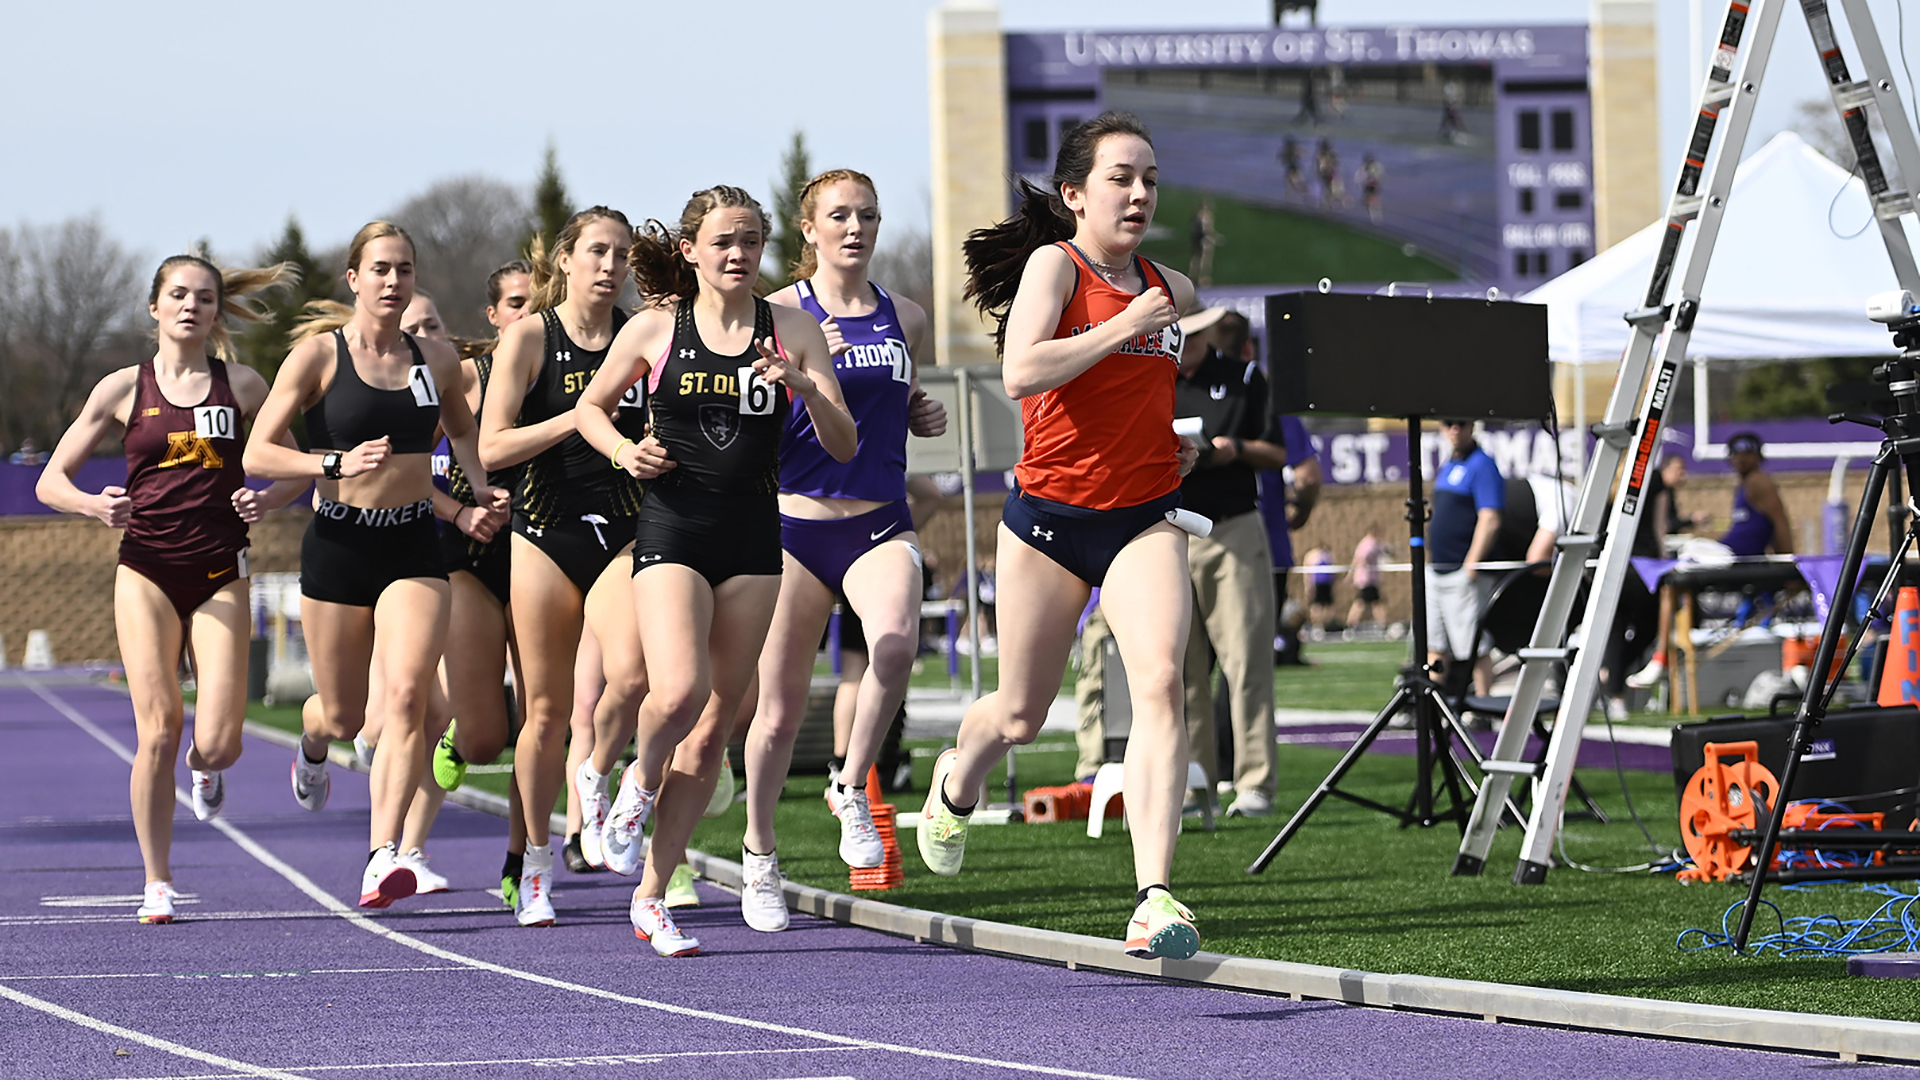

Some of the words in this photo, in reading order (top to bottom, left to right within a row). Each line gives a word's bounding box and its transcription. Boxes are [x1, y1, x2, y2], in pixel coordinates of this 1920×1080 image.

[1065, 30, 1268, 66] UNIVERSITY
[1385, 24, 1535, 61] THOMAS
[844, 344, 894, 369] THOM
[892, 341, 906, 380] 7
[415, 368, 433, 403] 1
[679, 372, 709, 396] ST.
[713, 374, 738, 397] OL
[748, 368, 769, 413] 6
[1652, 368, 1673, 410] MULTI
[203, 408, 229, 437] 10
[1330, 433, 1400, 484] ST.
[355, 504, 414, 527] NIKE
